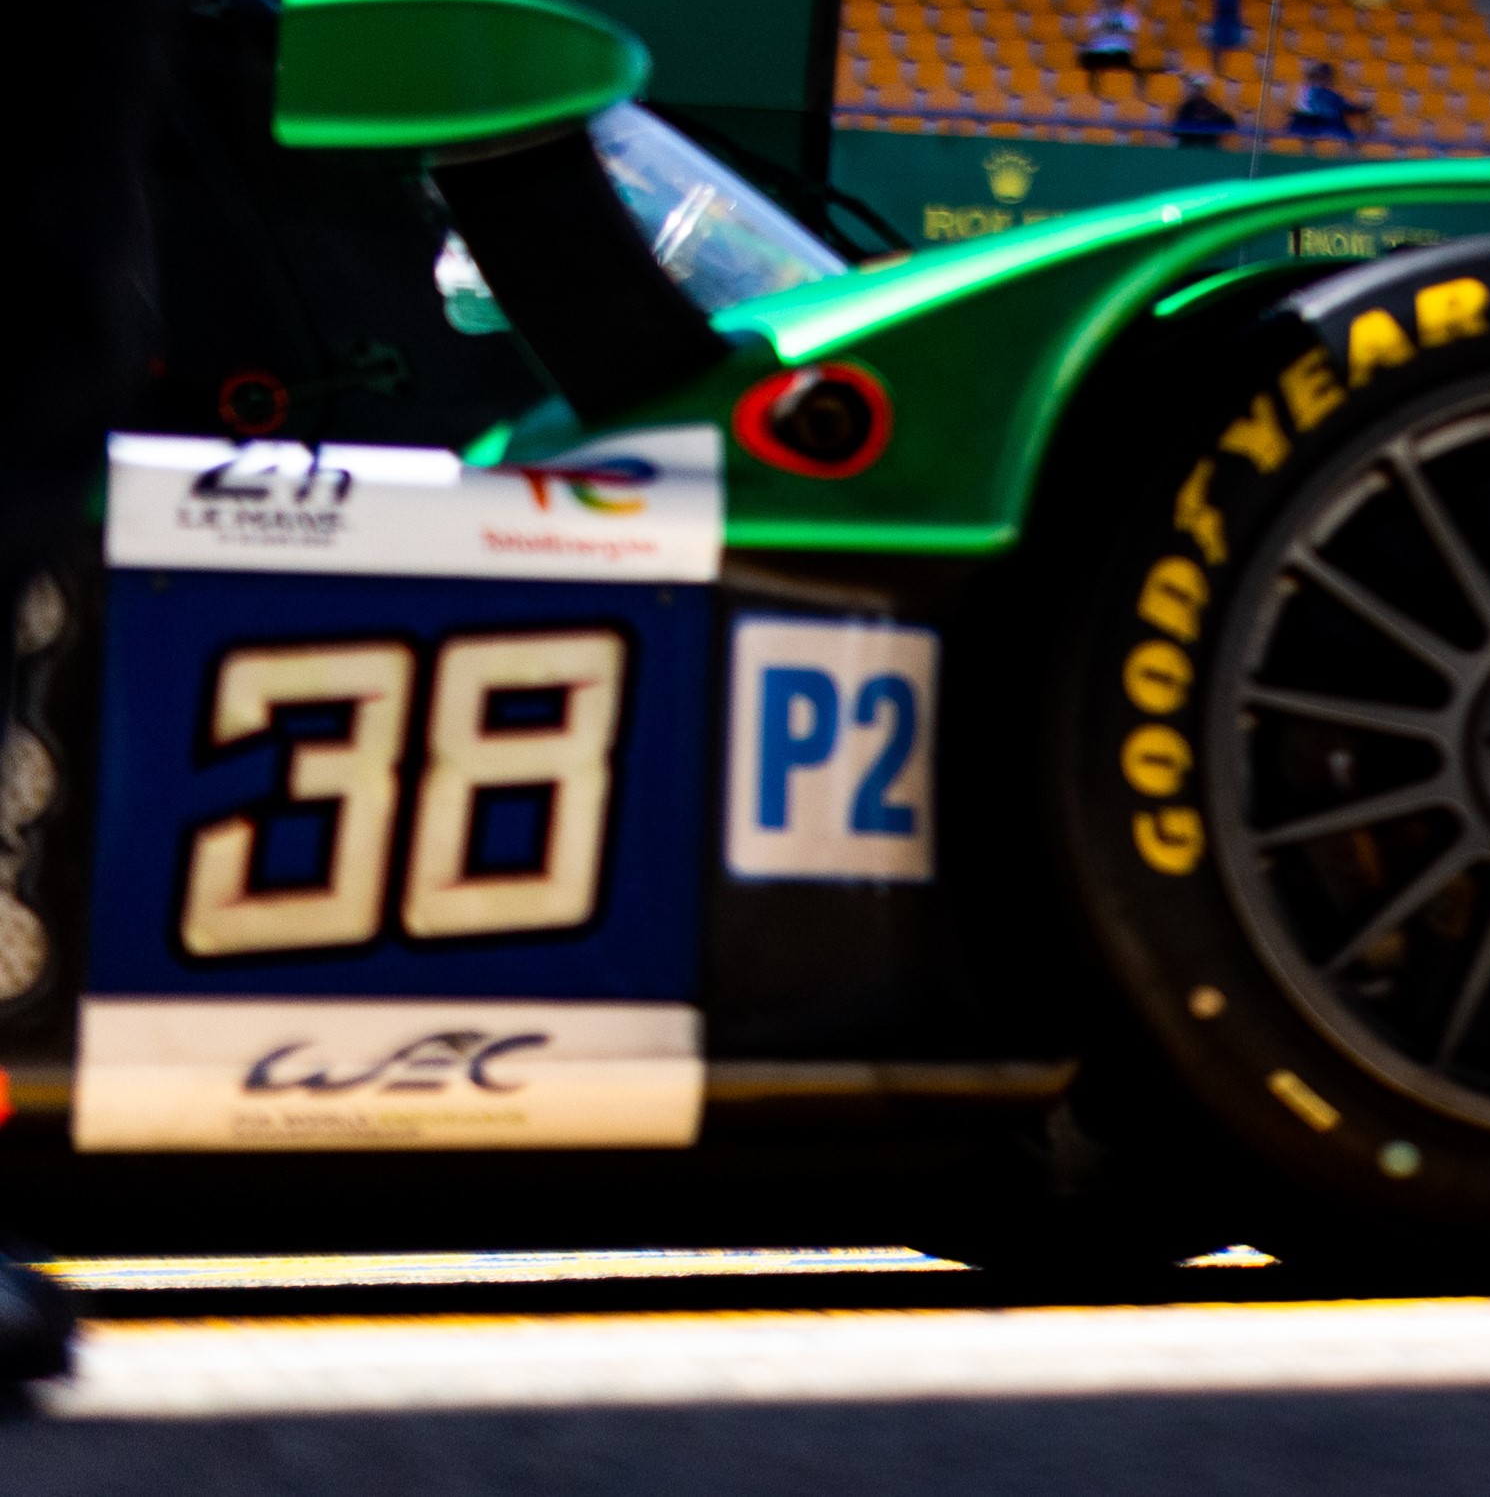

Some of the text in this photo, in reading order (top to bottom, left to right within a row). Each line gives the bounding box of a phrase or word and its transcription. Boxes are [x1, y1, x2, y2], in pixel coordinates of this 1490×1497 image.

[180, 628, 627, 958] 38
[756, 665, 917, 836] P2
[242, 1030, 551, 1094] WEC
